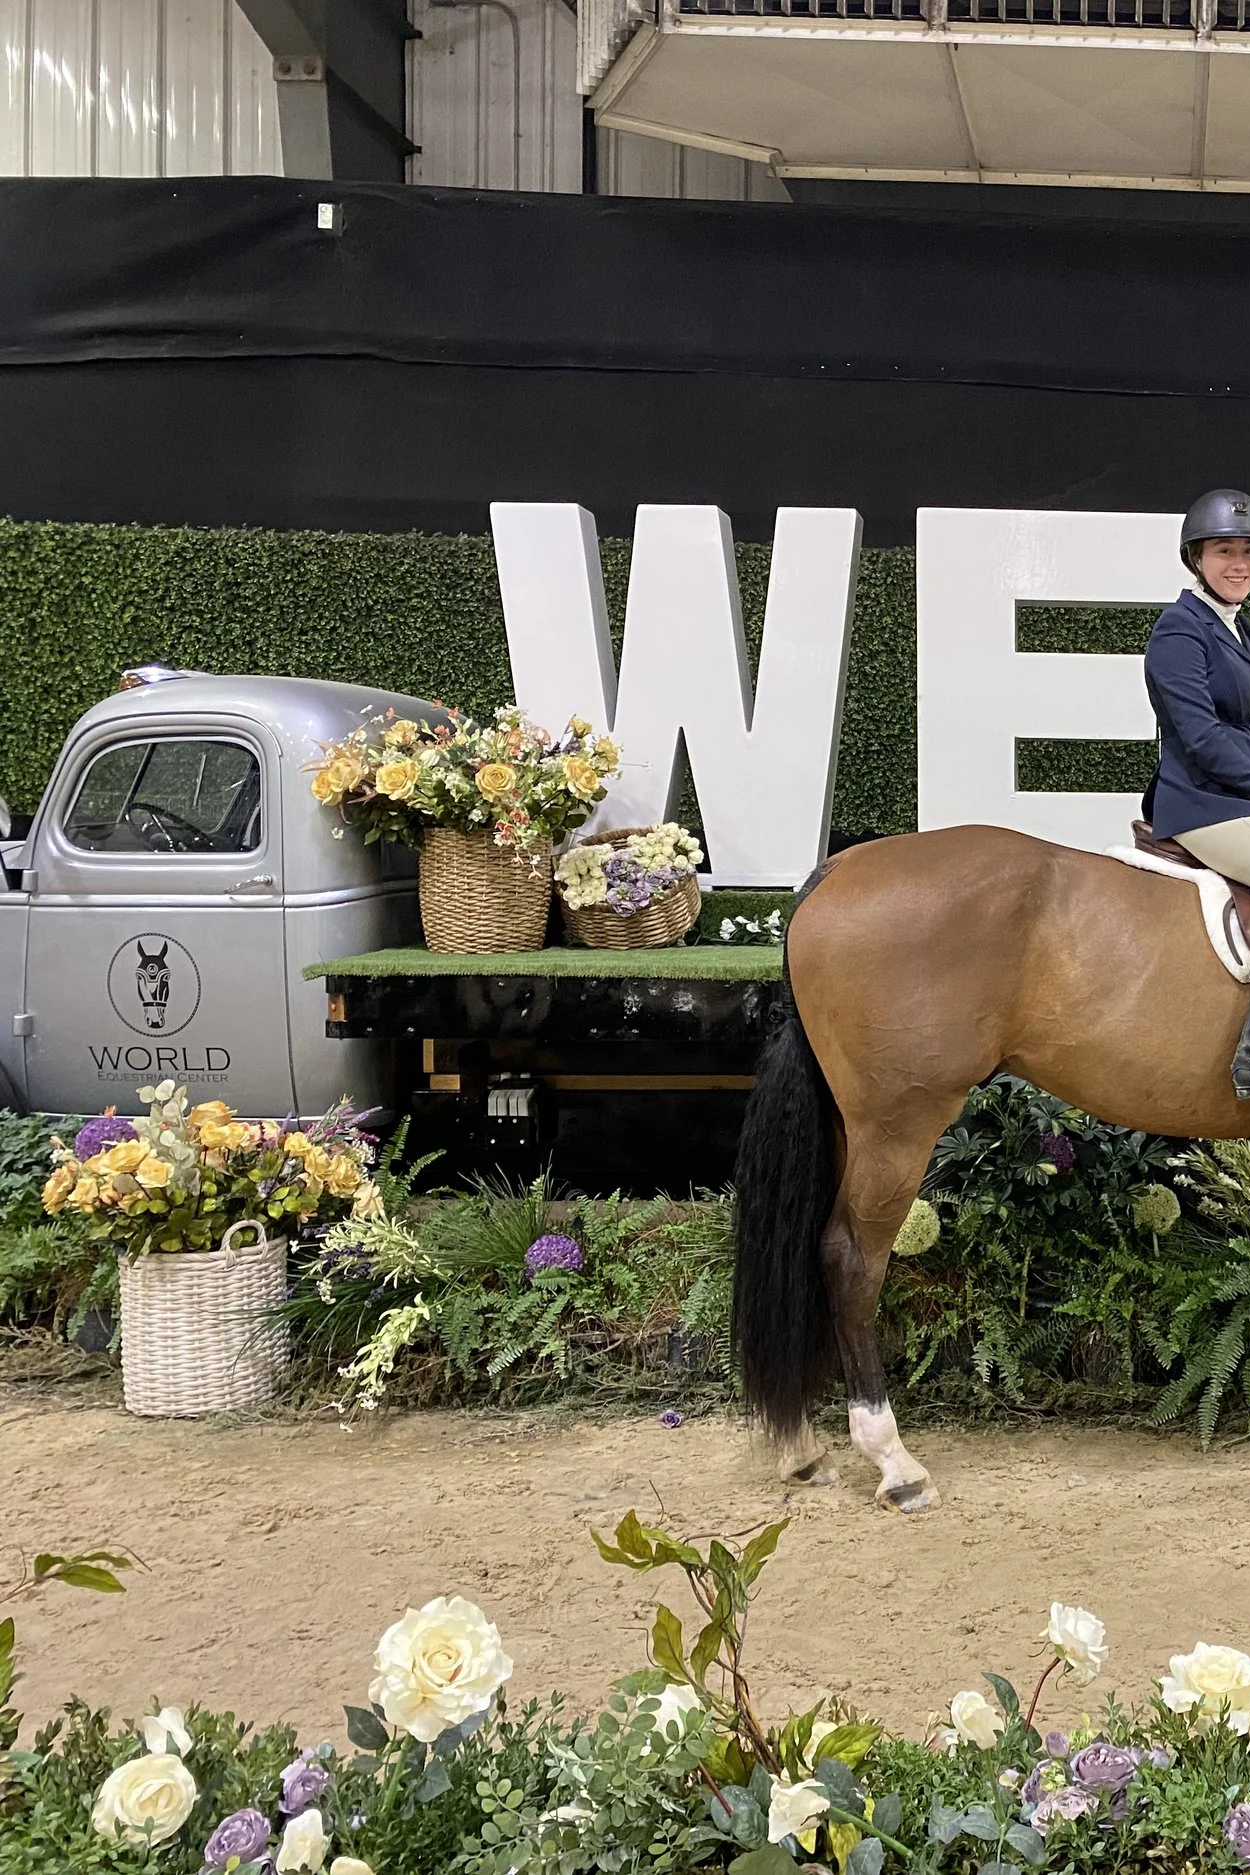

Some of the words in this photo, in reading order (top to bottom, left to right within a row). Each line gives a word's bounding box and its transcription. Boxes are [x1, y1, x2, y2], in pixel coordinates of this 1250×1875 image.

[88, 1045, 231, 1072] WORLD
[97, 1071, 174, 1082] EQUESTRIAN
[177, 1072, 229, 1083] CENTER
